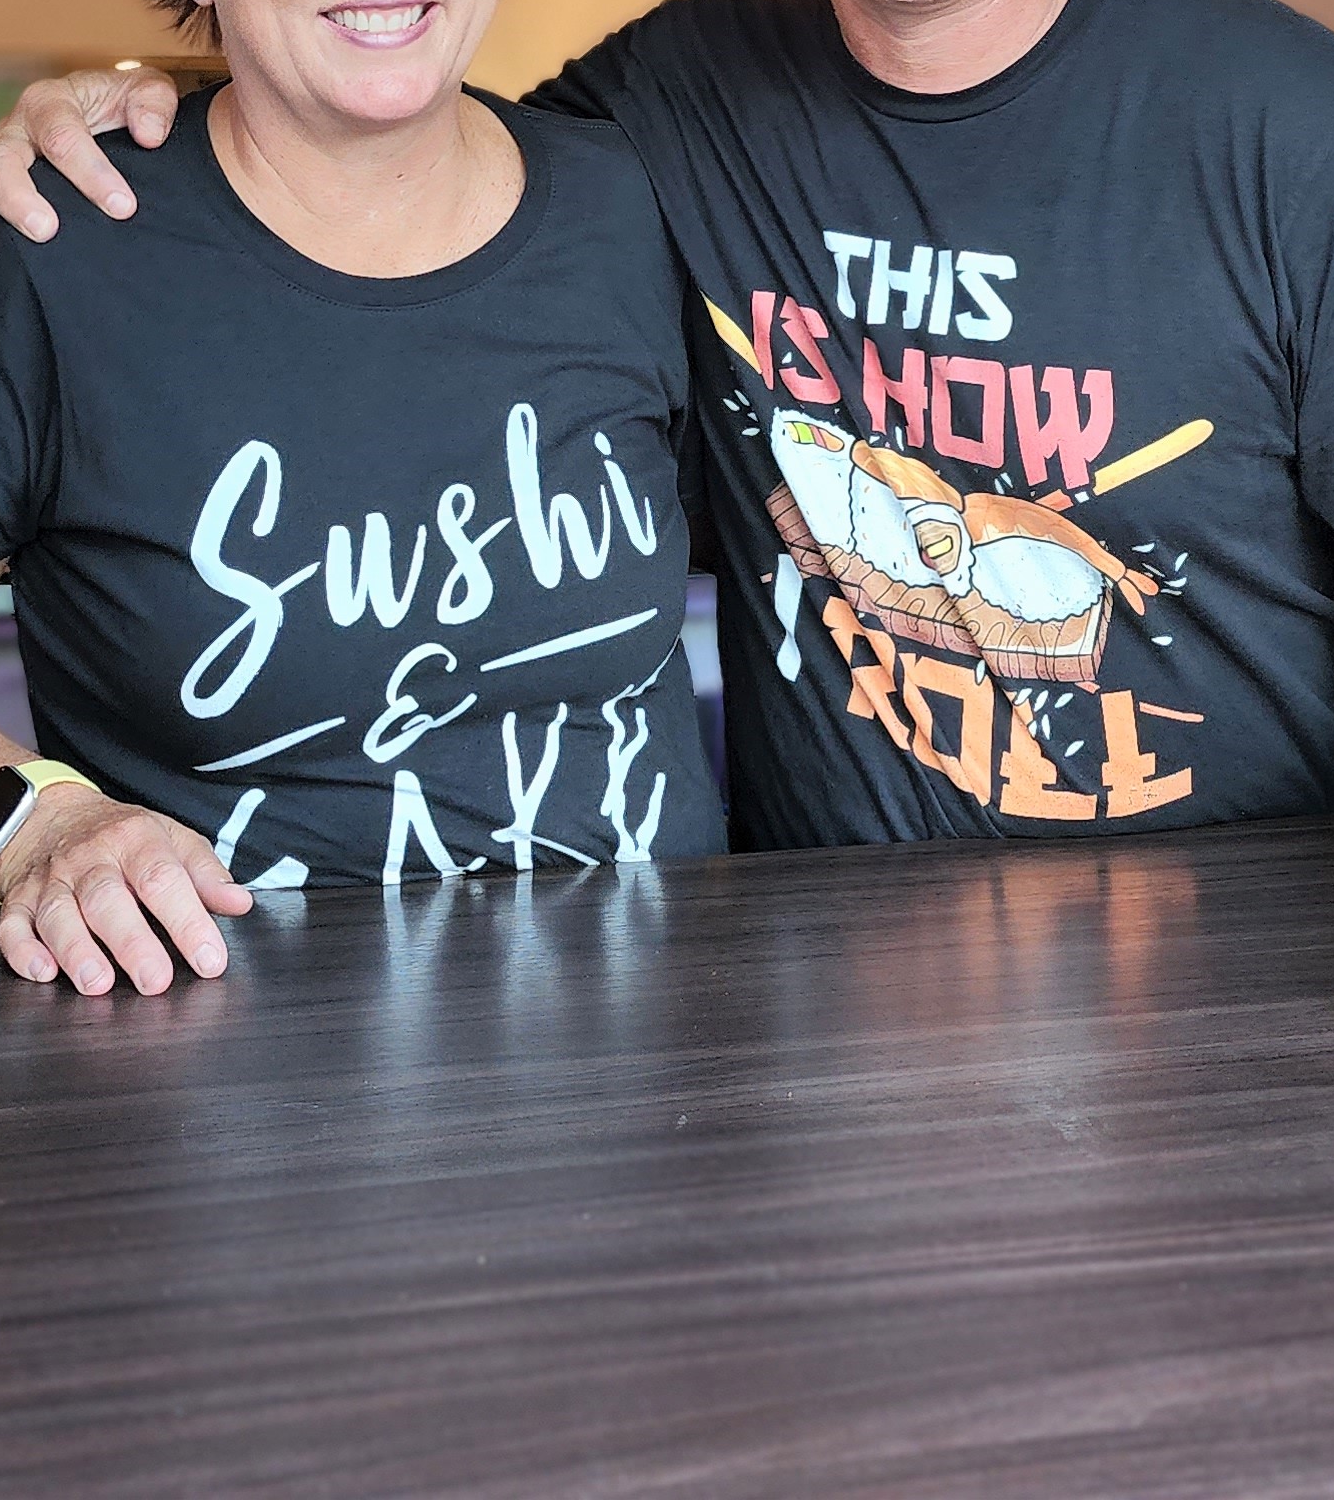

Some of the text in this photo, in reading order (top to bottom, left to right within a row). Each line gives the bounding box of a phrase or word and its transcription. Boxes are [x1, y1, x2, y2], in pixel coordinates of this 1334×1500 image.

[823, 230, 1017, 341] THIS
[750, 291, 1114, 488] IS HOW
[180, 403, 657, 719] Sushi
[363, 642, 478, 763] &
[821, 596, 1195, 820] ROLL
